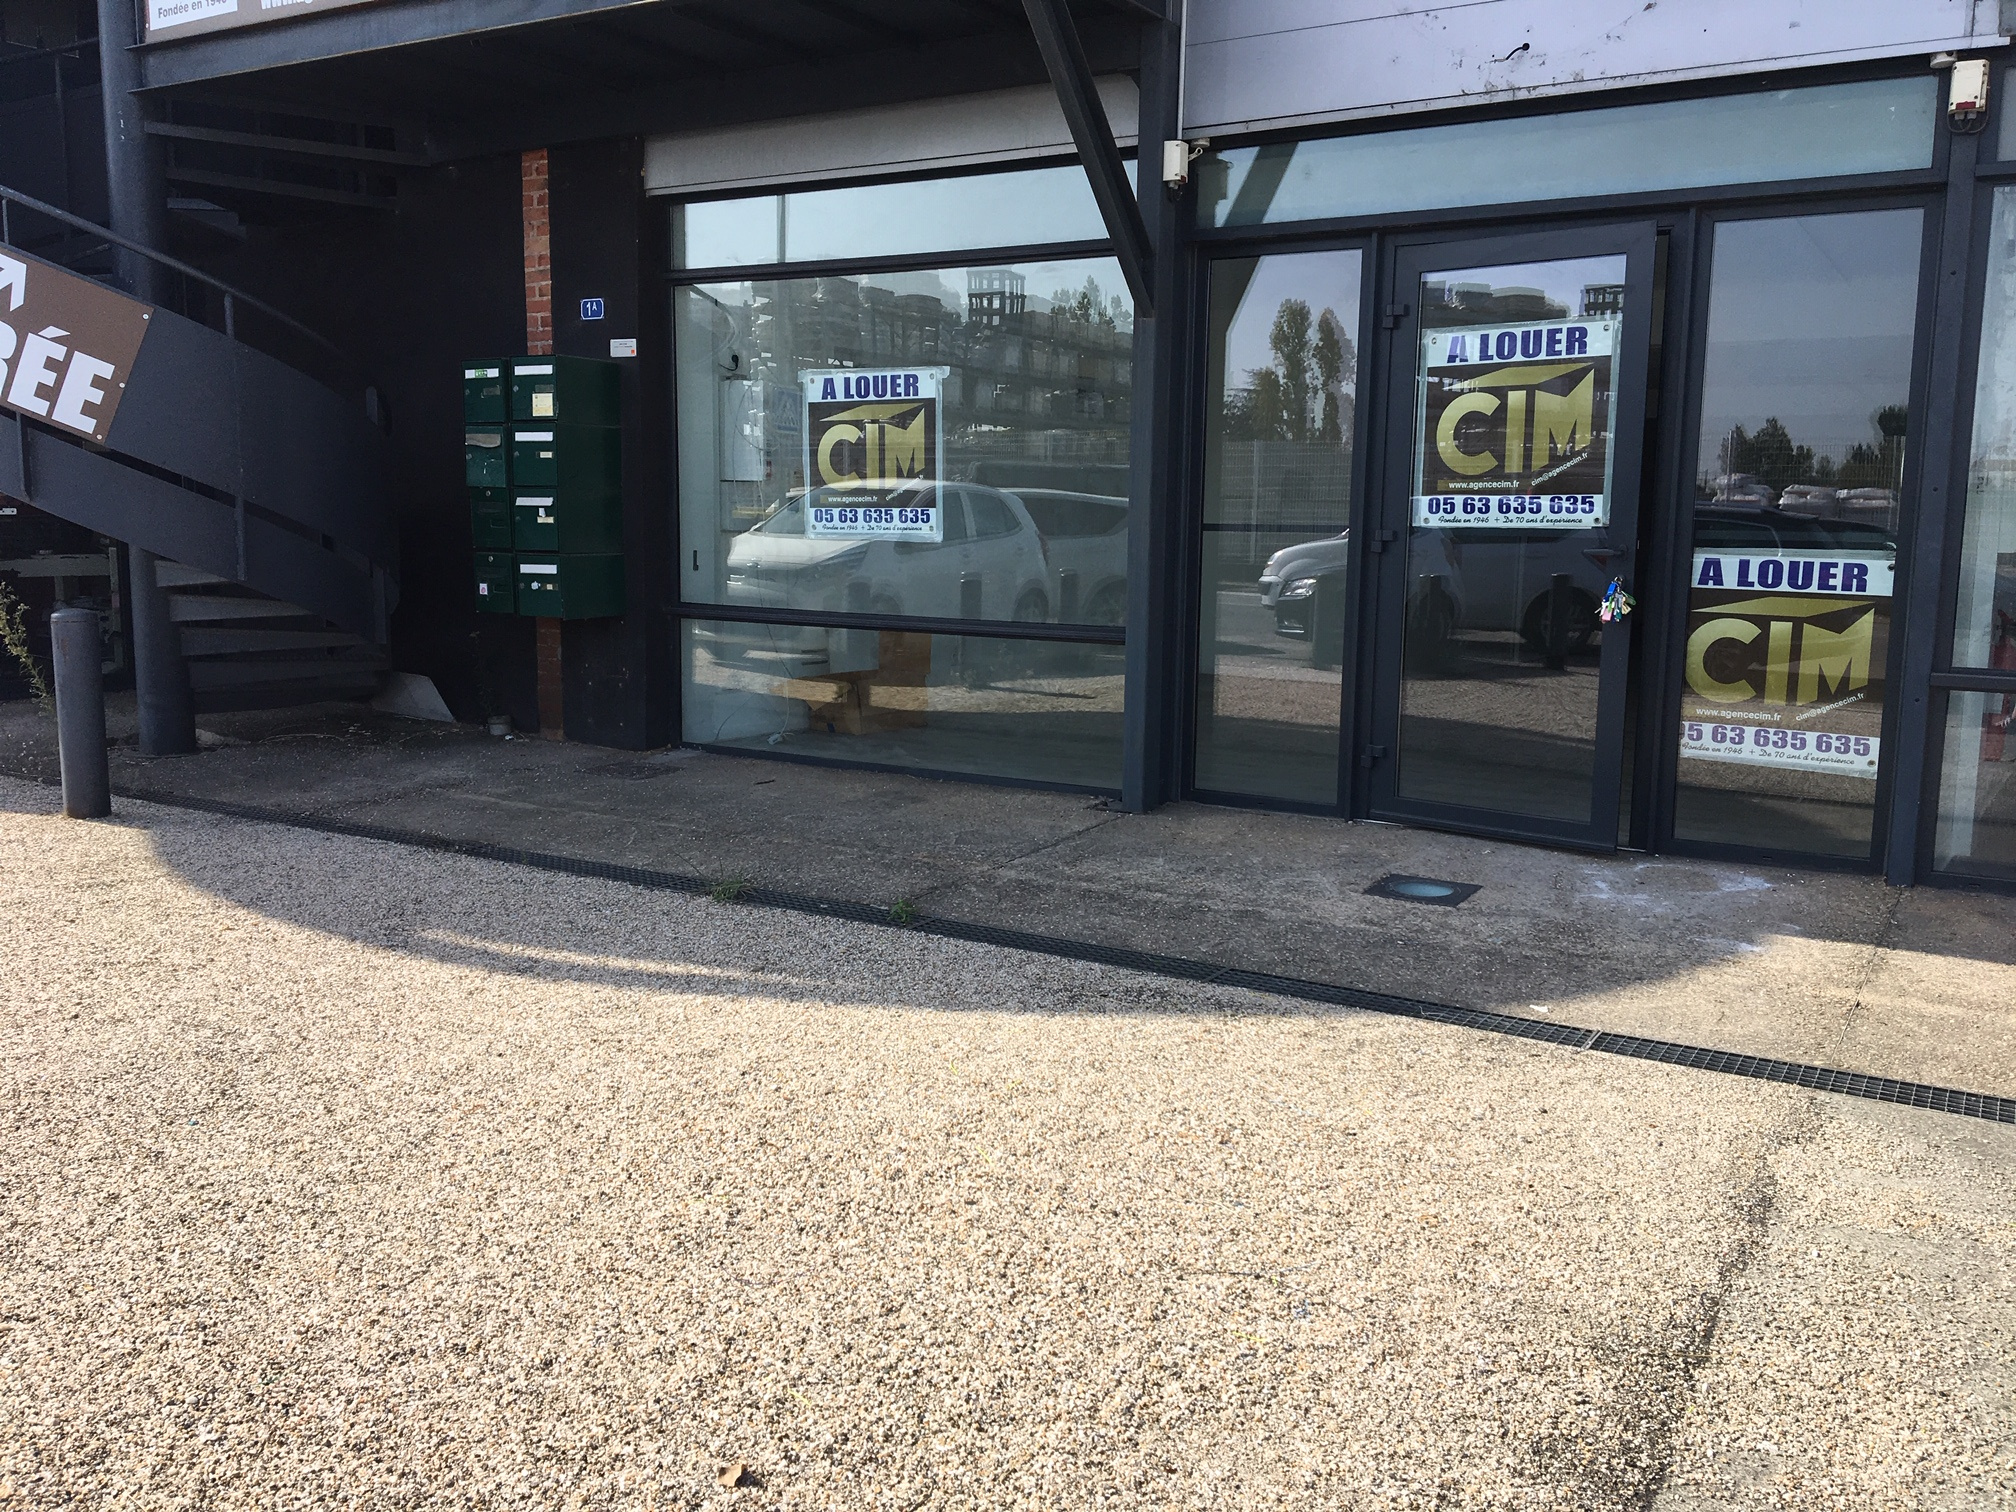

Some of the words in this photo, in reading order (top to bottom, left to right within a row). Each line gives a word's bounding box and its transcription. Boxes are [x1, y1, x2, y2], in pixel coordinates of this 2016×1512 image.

[158, 2, 189, 18] Fondée
[192, 1, 202, 11] en
[586, 301, 598, 317] 1A
[1446, 335, 1469, 364] A
[1479, 326, 1588, 362] LOUER
[821, 377, 837, 400] A
[843, 374, 919, 399] LOUER
[1436, 368, 1594, 476] CIM
[817, 407, 925, 492] CIM
[1449, 480, 1520, 490] www.agencecim.fr
[1428, 496, 1456, 514] 05
[1462, 496, 1490, 514] 63
[1498, 496, 1542, 514] 635
[1549, 495, 1594, 514] 635
[814, 509, 834, 523] 05
[838, 509, 858, 523] 63
[863, 509, 894, 523] 635
[898, 509, 930, 524] 635
[1473, 516, 1490, 524] 1946
[1503, 516, 1514, 524] De
[1515, 516, 1525, 524] 70
[1697, 558, 1724, 586] A
[1737, 559, 1869, 592] LOUER
[1685, 608, 1875, 706] CIM
[1696, 708, 1782, 721] www.agencecim.fr
[1712, 725, 1746, 745] 63
[1754, 728, 1807, 751] 635
[1815, 734, 1870, 756] 635
[1759, 749, 1772, 757] De
[1774, 751, 1785, 759] 70
